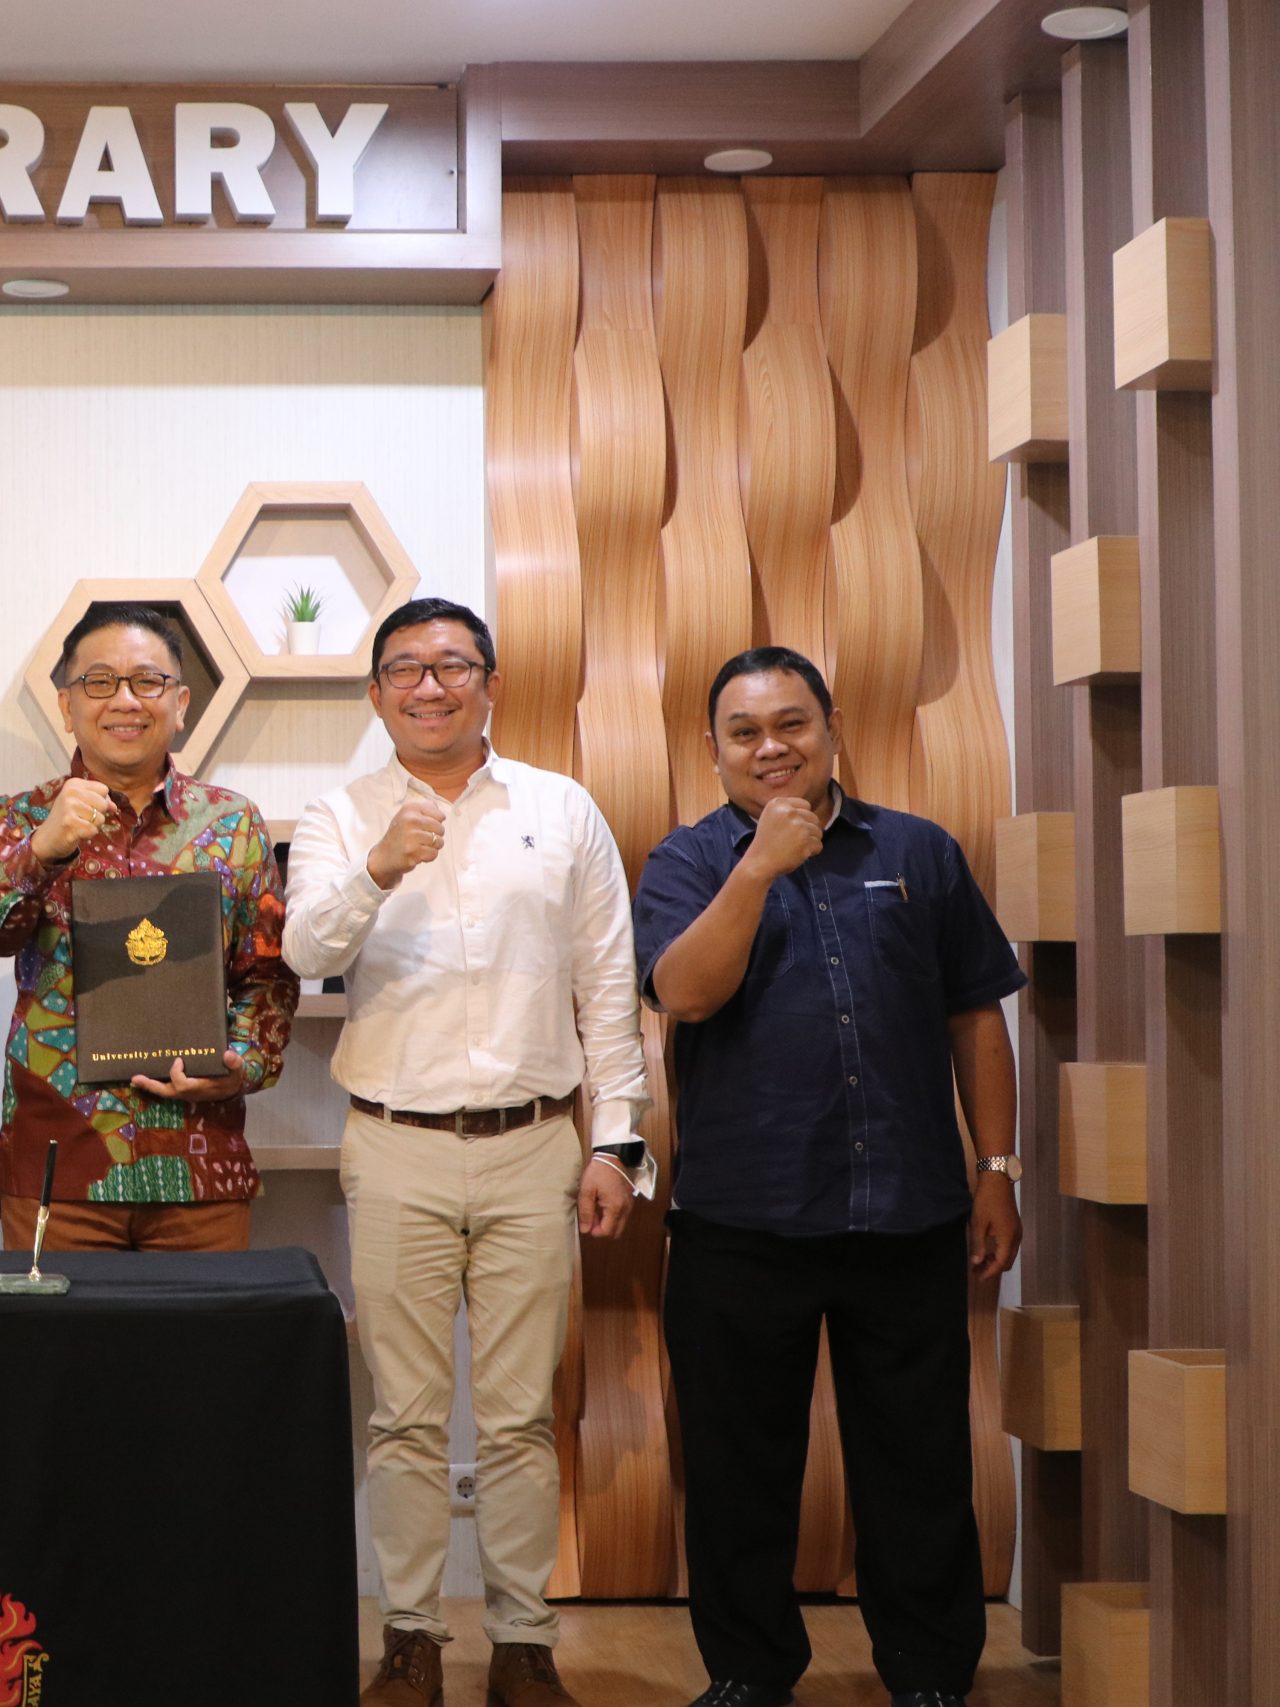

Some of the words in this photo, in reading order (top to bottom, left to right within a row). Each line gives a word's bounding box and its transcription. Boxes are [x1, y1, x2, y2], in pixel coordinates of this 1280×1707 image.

[91, 1050, 149, 1062] University
[151, 1049, 162, 1058] of
[165, 1047, 216, 1058] Surabaya
